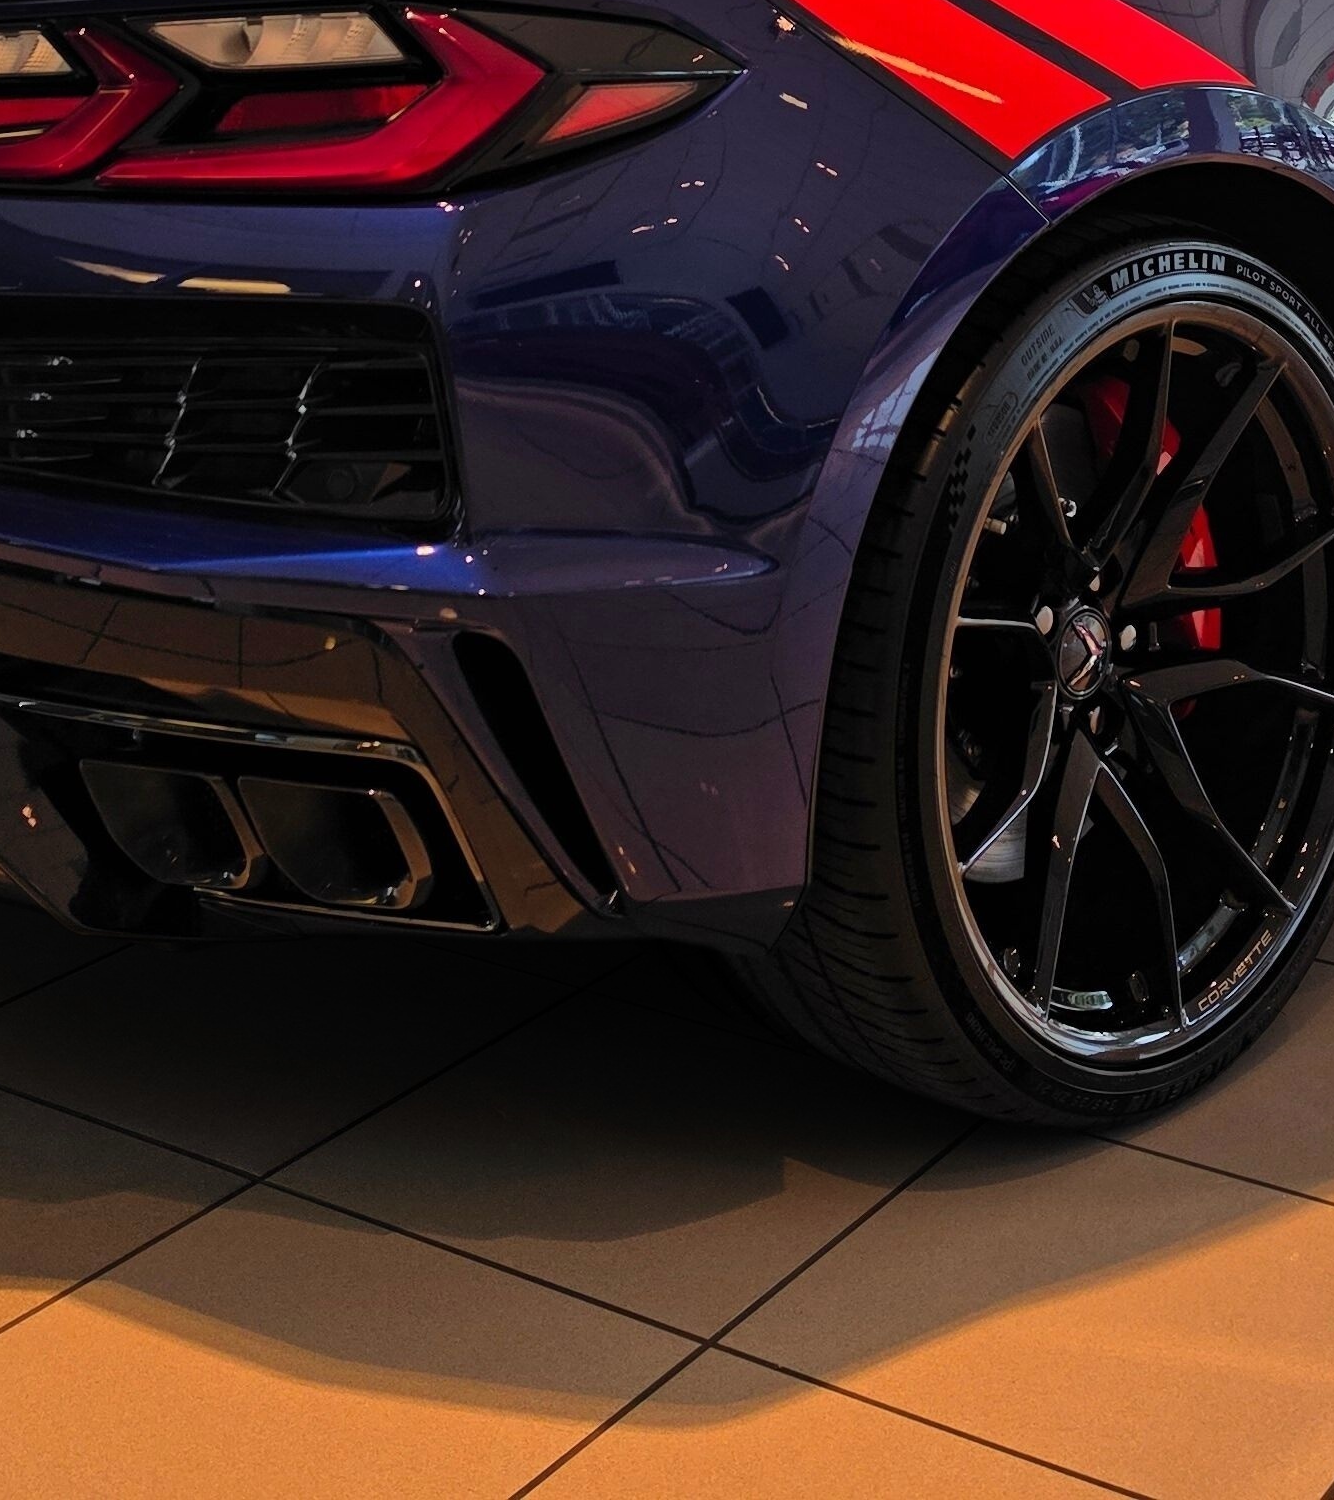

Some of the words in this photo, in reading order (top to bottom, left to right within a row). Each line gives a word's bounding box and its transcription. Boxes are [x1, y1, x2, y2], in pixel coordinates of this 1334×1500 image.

[1110, 253, 1225, 292] MICHELIN
[1236, 264, 1267, 285] PILOT
[1269, 281, 1302, 312] SPORT
[1304, 312, 1321, 335] ALL
[1197, 929, 1274, 1012] CORVETTE
